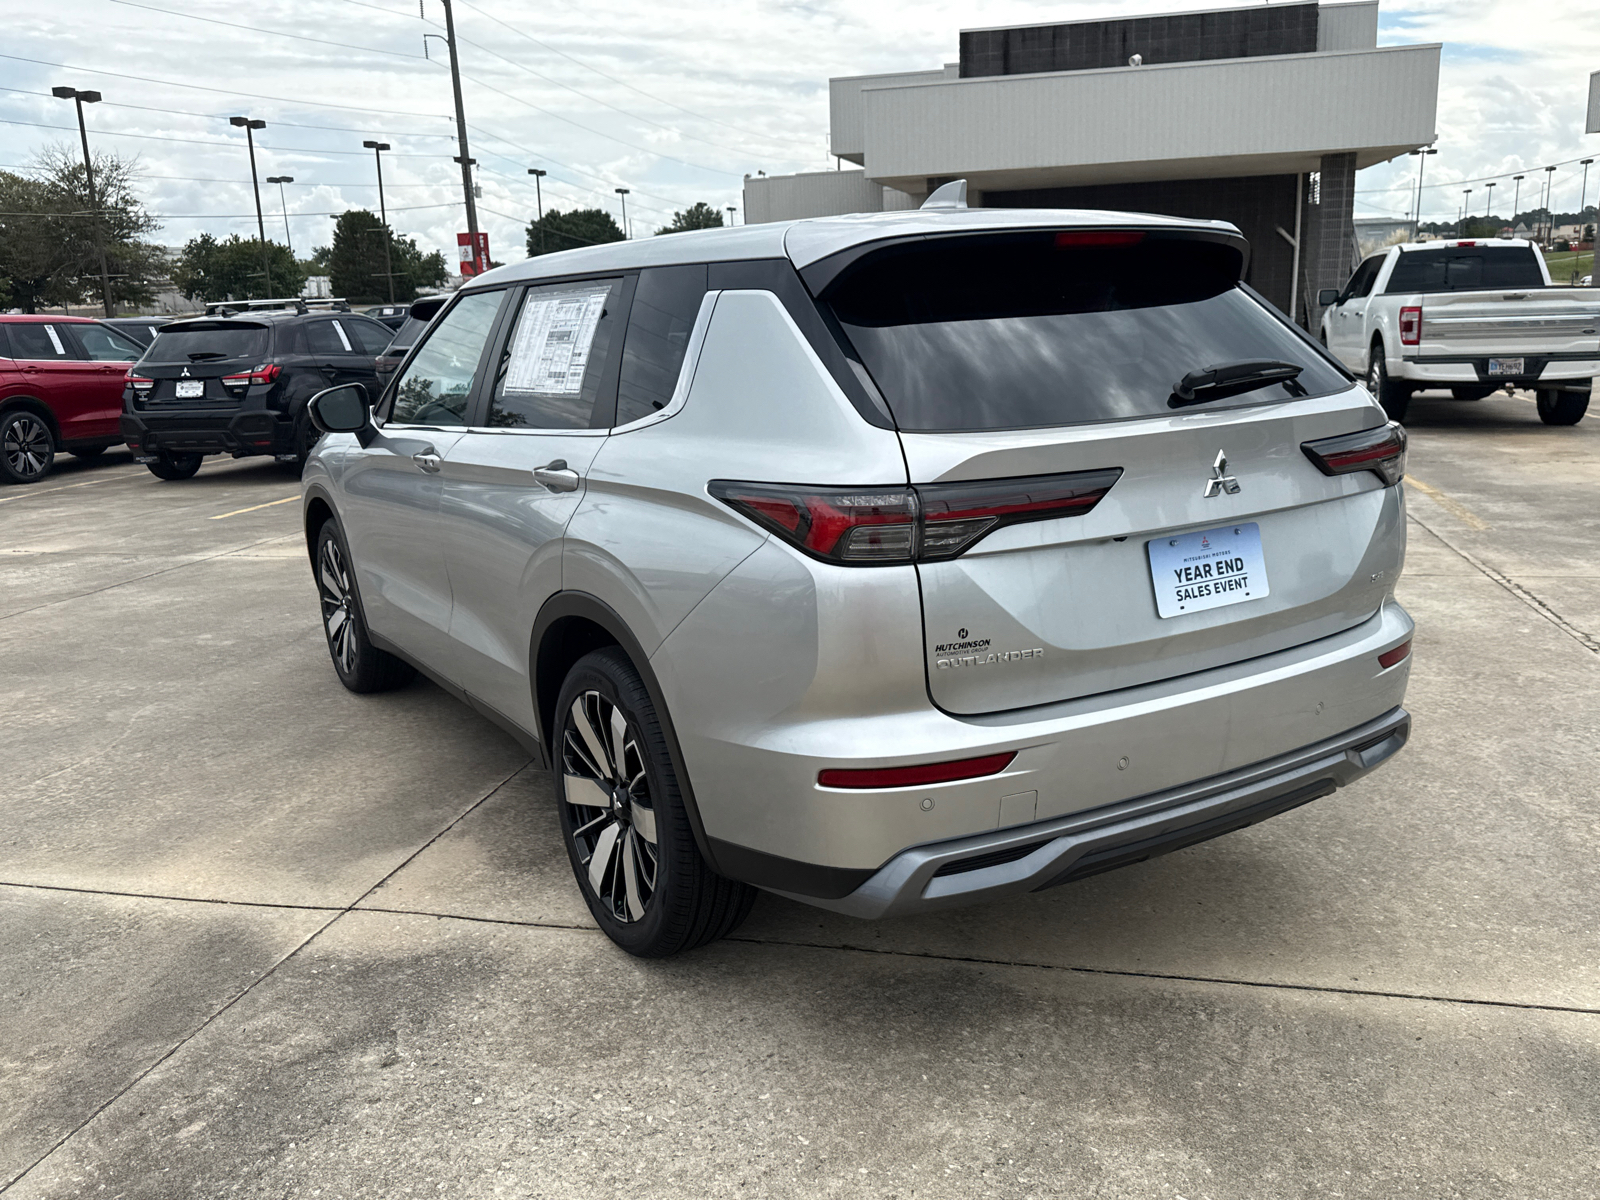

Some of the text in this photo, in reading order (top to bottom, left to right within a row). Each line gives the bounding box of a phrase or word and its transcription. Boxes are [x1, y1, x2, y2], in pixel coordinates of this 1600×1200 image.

[1183, 554, 1211, 563] MITSUBISHI
[1174, 557, 1244, 583] YEAR END
[1176, 576, 1248, 602] SALES EVENT
[935, 639, 991, 652] HUTCHINSON
[936, 649, 970, 657] AUTOMOTIVE
[936, 648, 1044, 669] OUTLANDER
